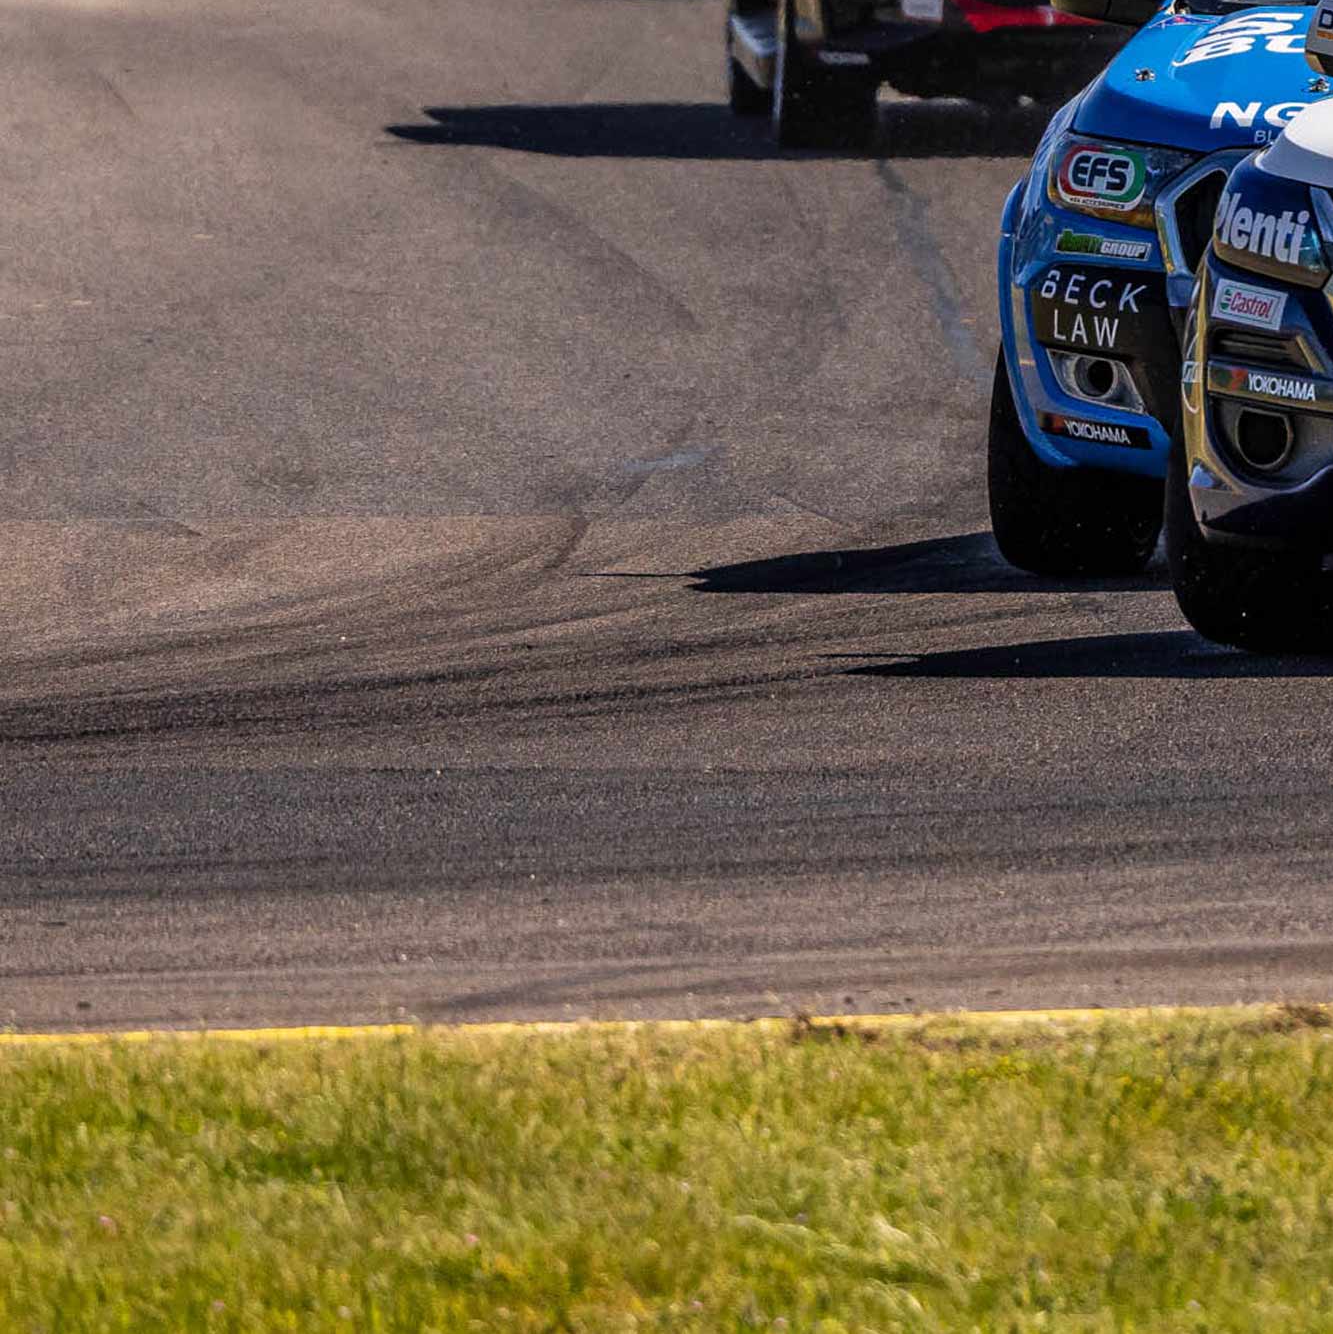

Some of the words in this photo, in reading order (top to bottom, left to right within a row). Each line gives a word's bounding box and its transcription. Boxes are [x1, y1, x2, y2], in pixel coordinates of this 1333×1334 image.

[1071, 152, 1132, 192] EFS
[1101, 239, 1147, 259] GROUP
[1040, 269, 1149, 314] BECK
[1230, 292, 1275, 319] Castrol
[1053, 308, 1119, 348] LAW
[1247, 372, 1316, 403] YOKOHAMA
[1064, 418, 1132, 446] YOKOHAMA
